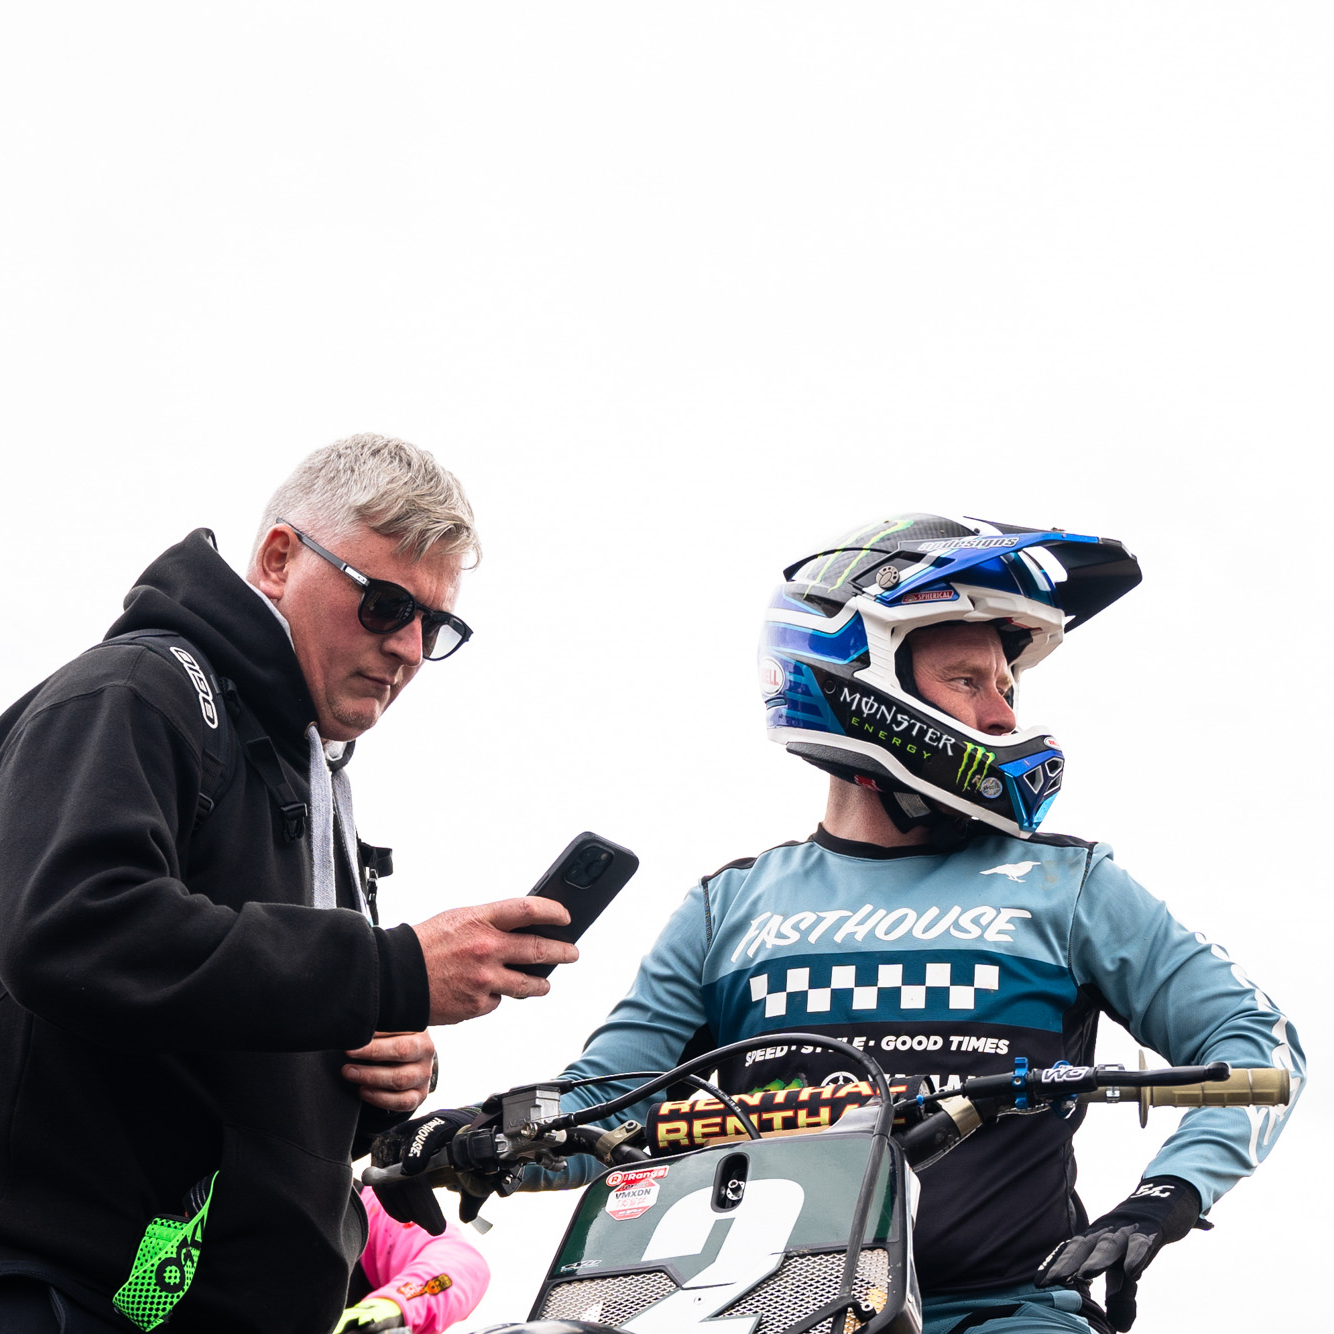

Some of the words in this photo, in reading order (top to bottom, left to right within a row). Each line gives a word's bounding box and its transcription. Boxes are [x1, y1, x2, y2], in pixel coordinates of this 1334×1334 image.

[918, 591, 952, 601] SPHERICAL
[840, 687, 955, 756] MONSTER
[851, 716, 932, 760] ENERGY
[730, 903, 1033, 963] FASTHOUSE
[880, 1036, 943, 1051] GOOD
[949, 1036, 1009, 1054] TIMES
[615, 1188, 651, 1200] VMXDN
